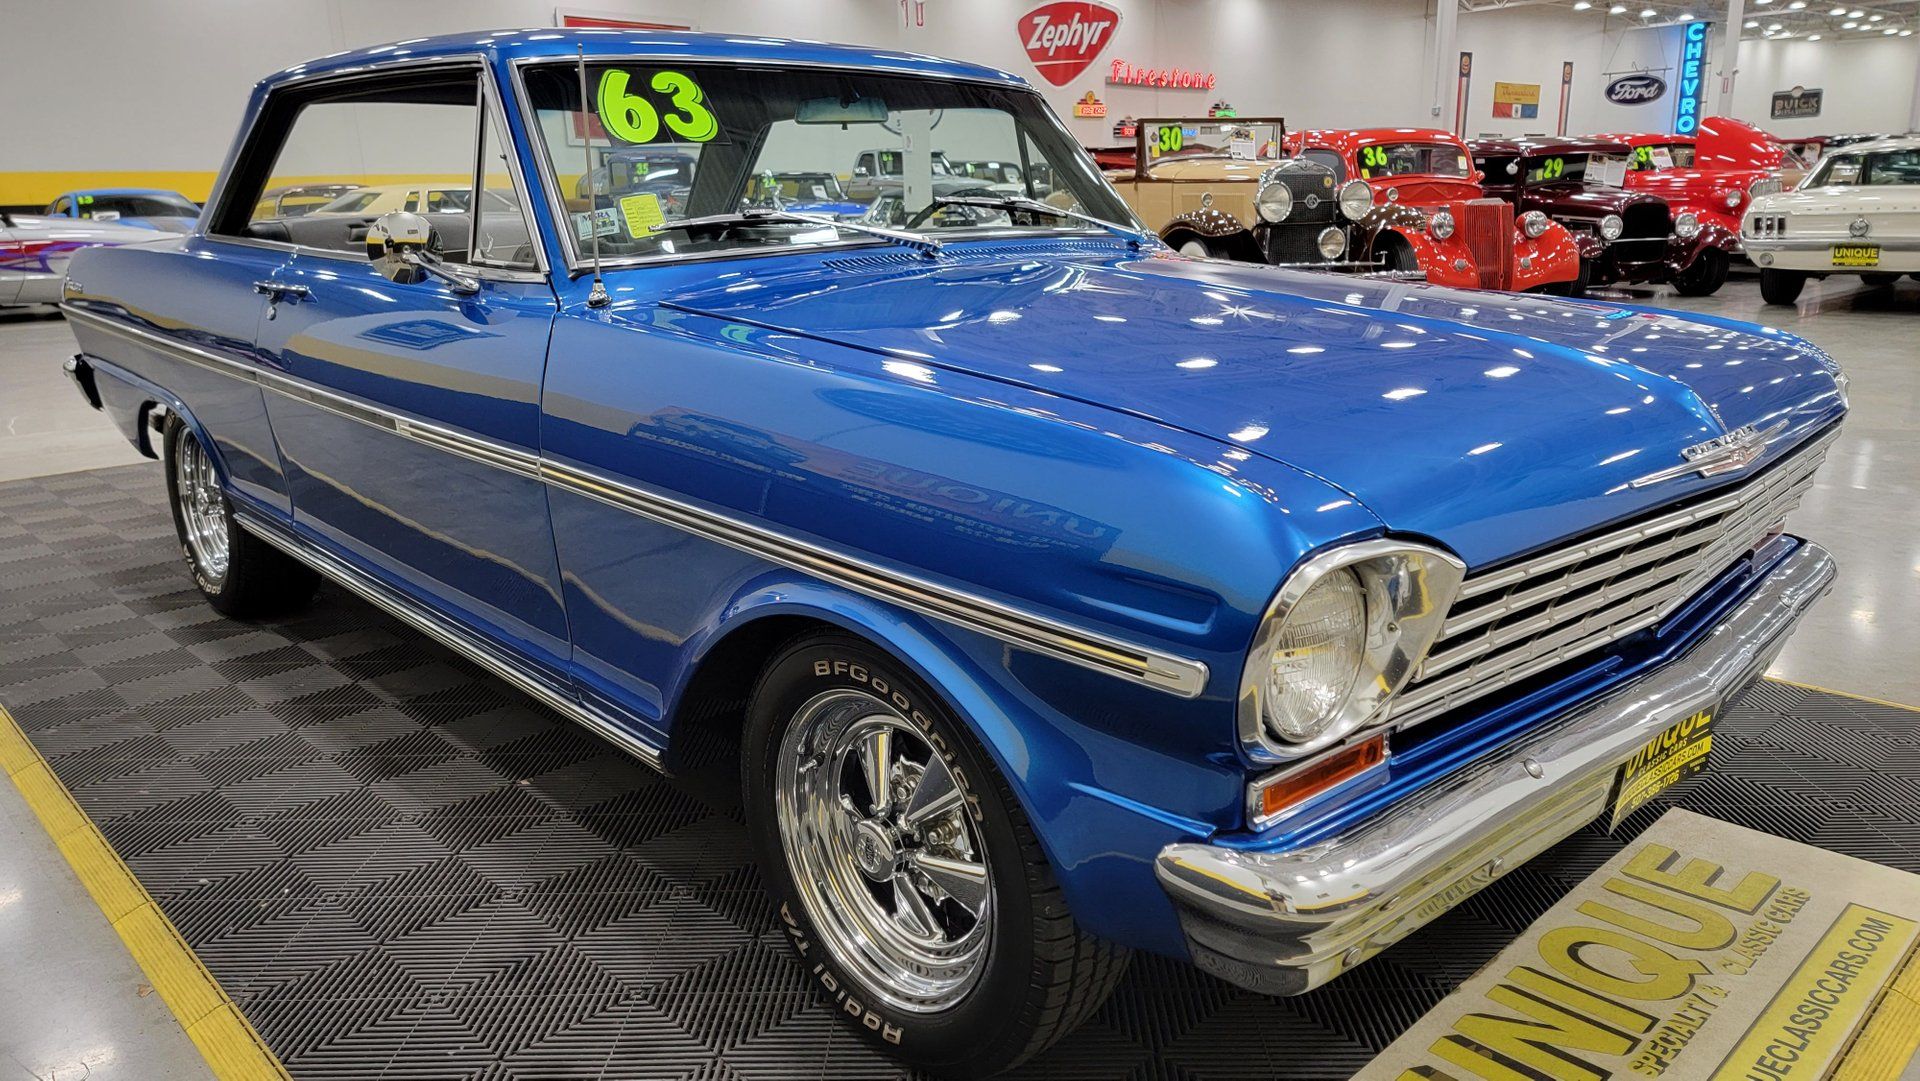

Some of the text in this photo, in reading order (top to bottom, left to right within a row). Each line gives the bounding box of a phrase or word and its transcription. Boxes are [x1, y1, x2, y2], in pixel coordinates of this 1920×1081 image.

[1026, 12, 1110, 56] Zephyr
[1110, 59, 1216, 90] Firestone
[1677, 23, 1705, 133] CHEVRO
[1611, 79, 1660, 101] Ford
[597, 69, 719, 143] 63
[1774, 97, 1819, 111] BUICK
[1158, 126, 1182, 152] 30
[1362, 145, 1388, 167] 36
[1543, 157, 1564, 179] 29
[1835, 247, 1878, 258] UNIQUE
[1395, 843, 1782, 1081] NIQUE
